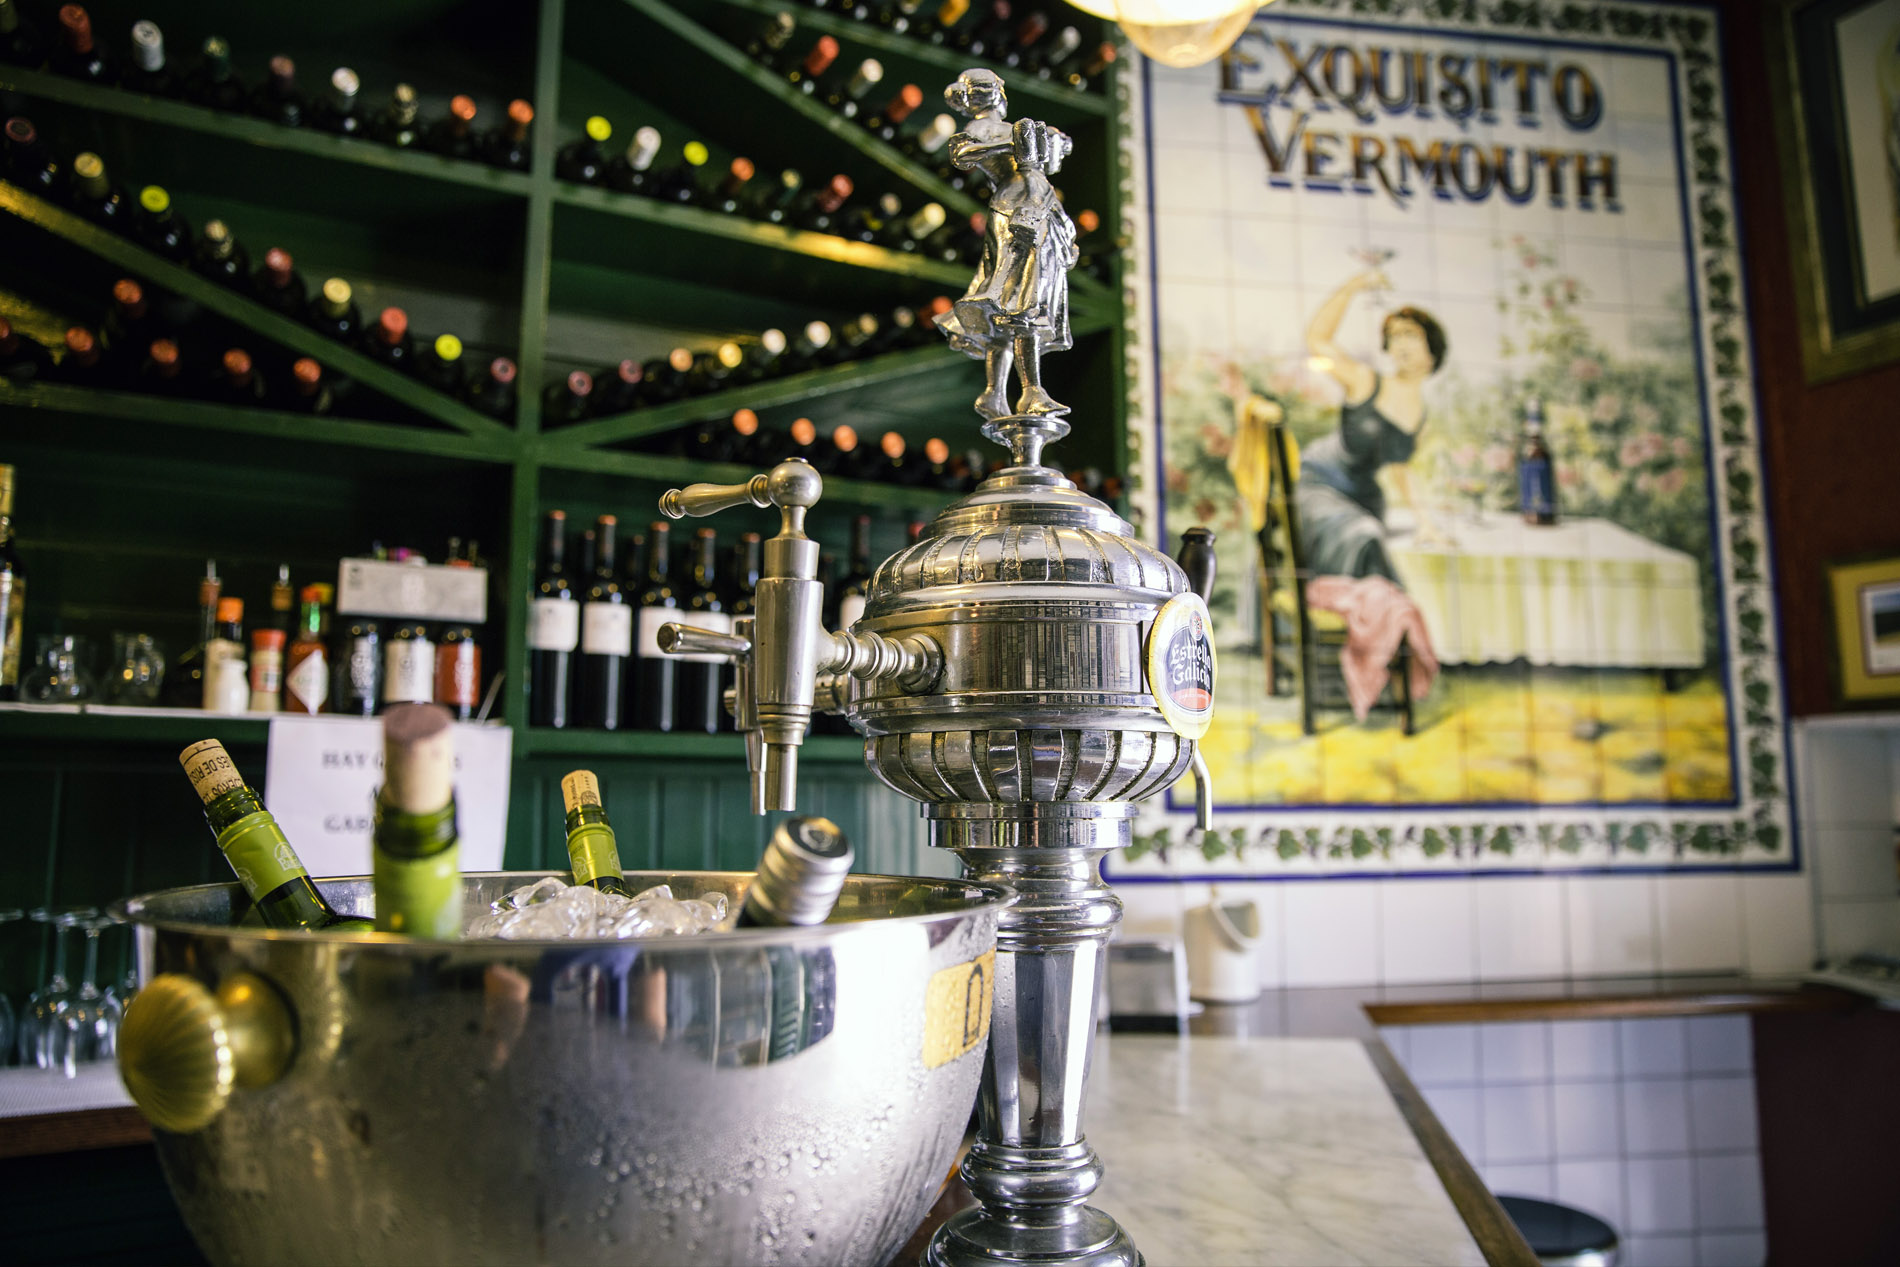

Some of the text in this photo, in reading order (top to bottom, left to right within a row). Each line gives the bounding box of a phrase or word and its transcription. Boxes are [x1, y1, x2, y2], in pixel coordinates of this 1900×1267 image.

[1217, 30, 1603, 132] EXQUISITO
[1243, 105, 1624, 213] VERMOUTH
[1170, 640, 1211, 671] Estrella
[1172, 660, 1211, 690] Galicia
